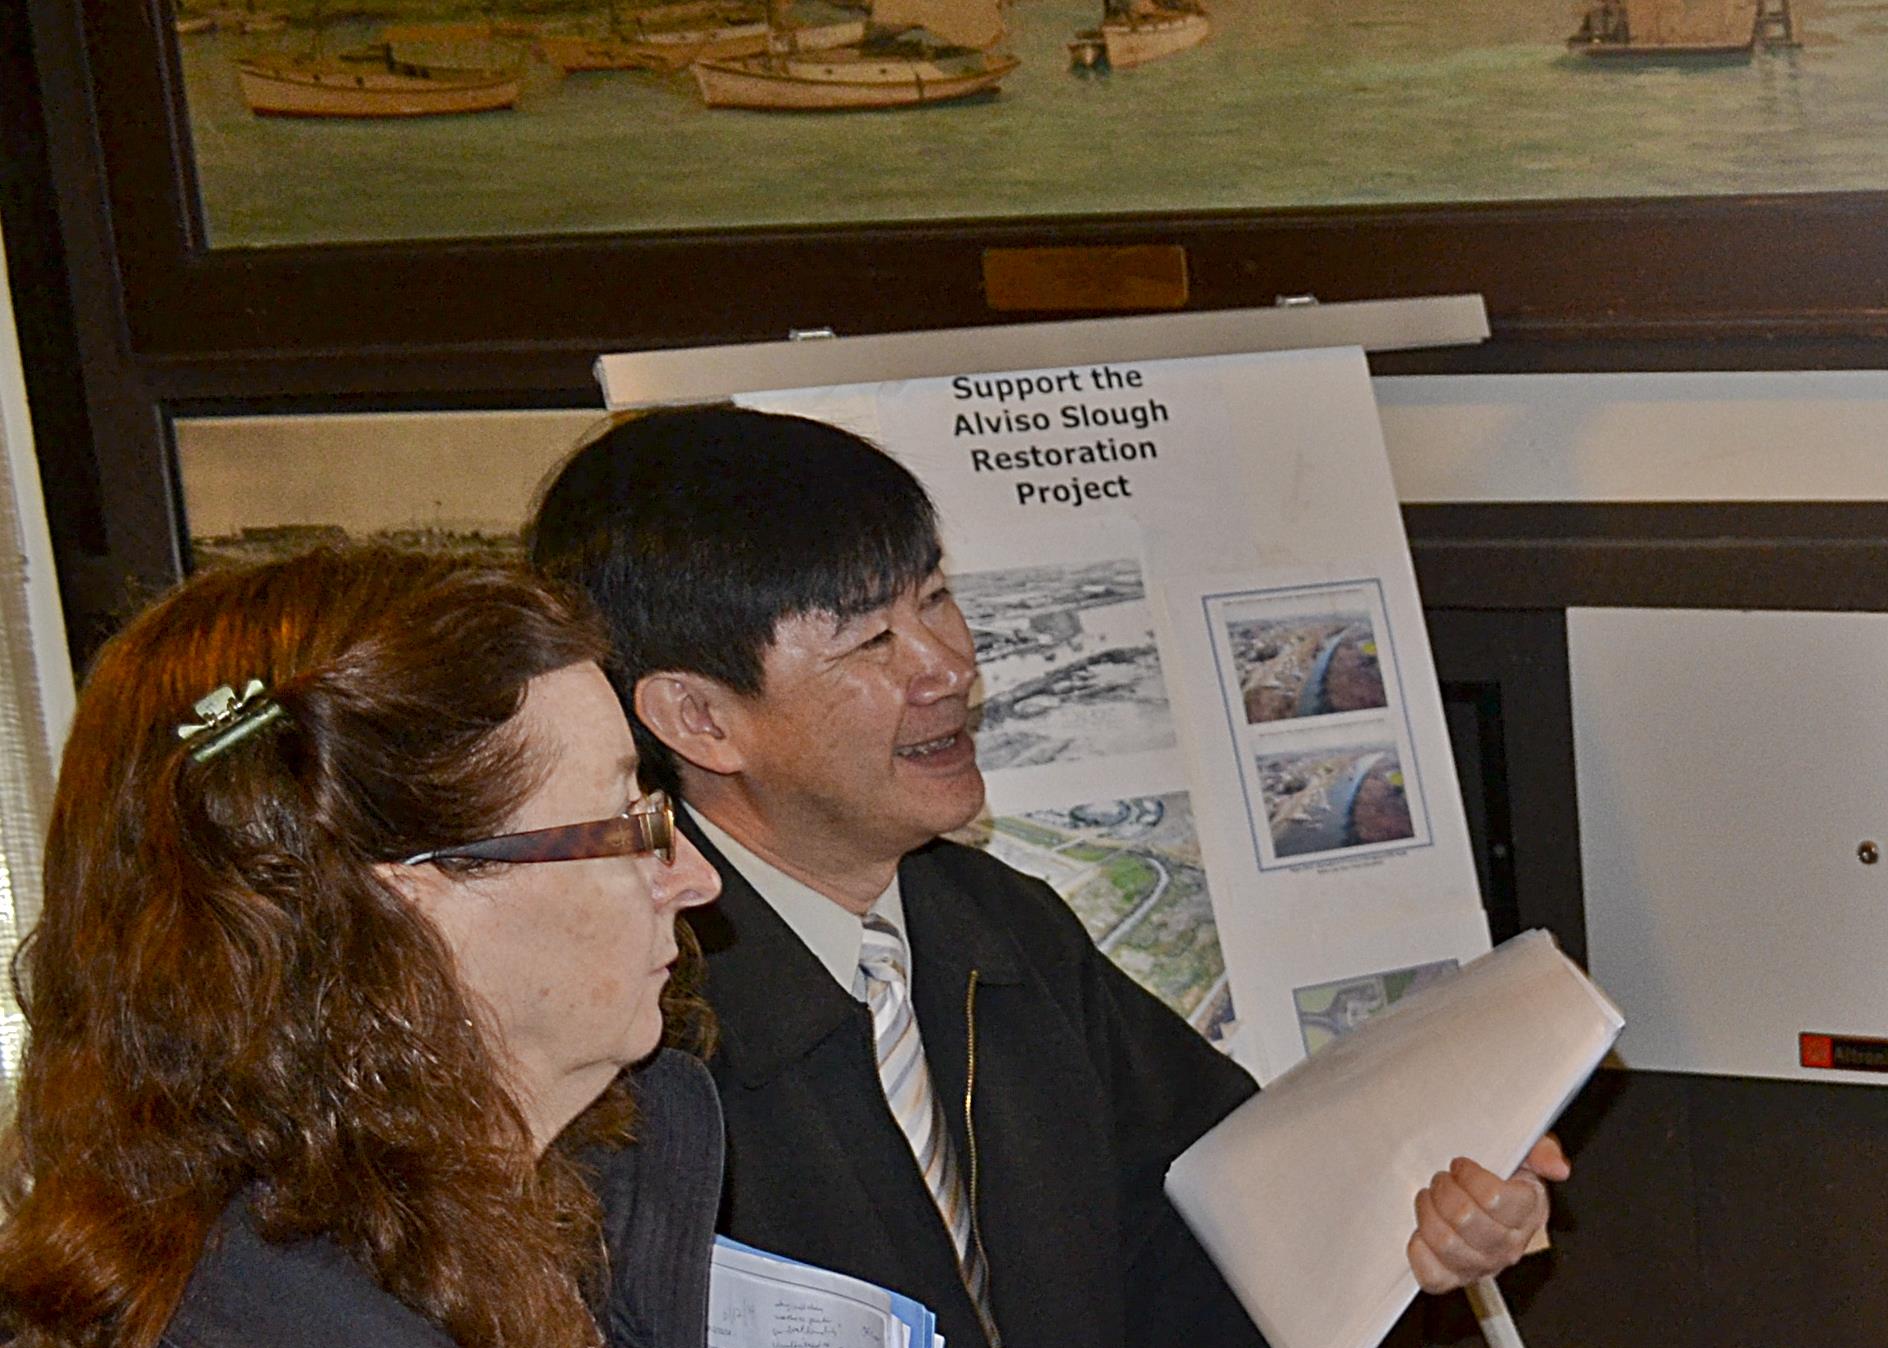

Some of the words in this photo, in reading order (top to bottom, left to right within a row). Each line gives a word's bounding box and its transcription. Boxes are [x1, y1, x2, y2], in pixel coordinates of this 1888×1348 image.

[952, 370, 1083, 402] Support
[1092, 366, 1143, 391] the
[953, 410, 1050, 437] Alviso
[1061, 399, 1169, 430] Slough
[971, 438, 1158, 472] Restoration
[1015, 475, 1132, 507] Project
